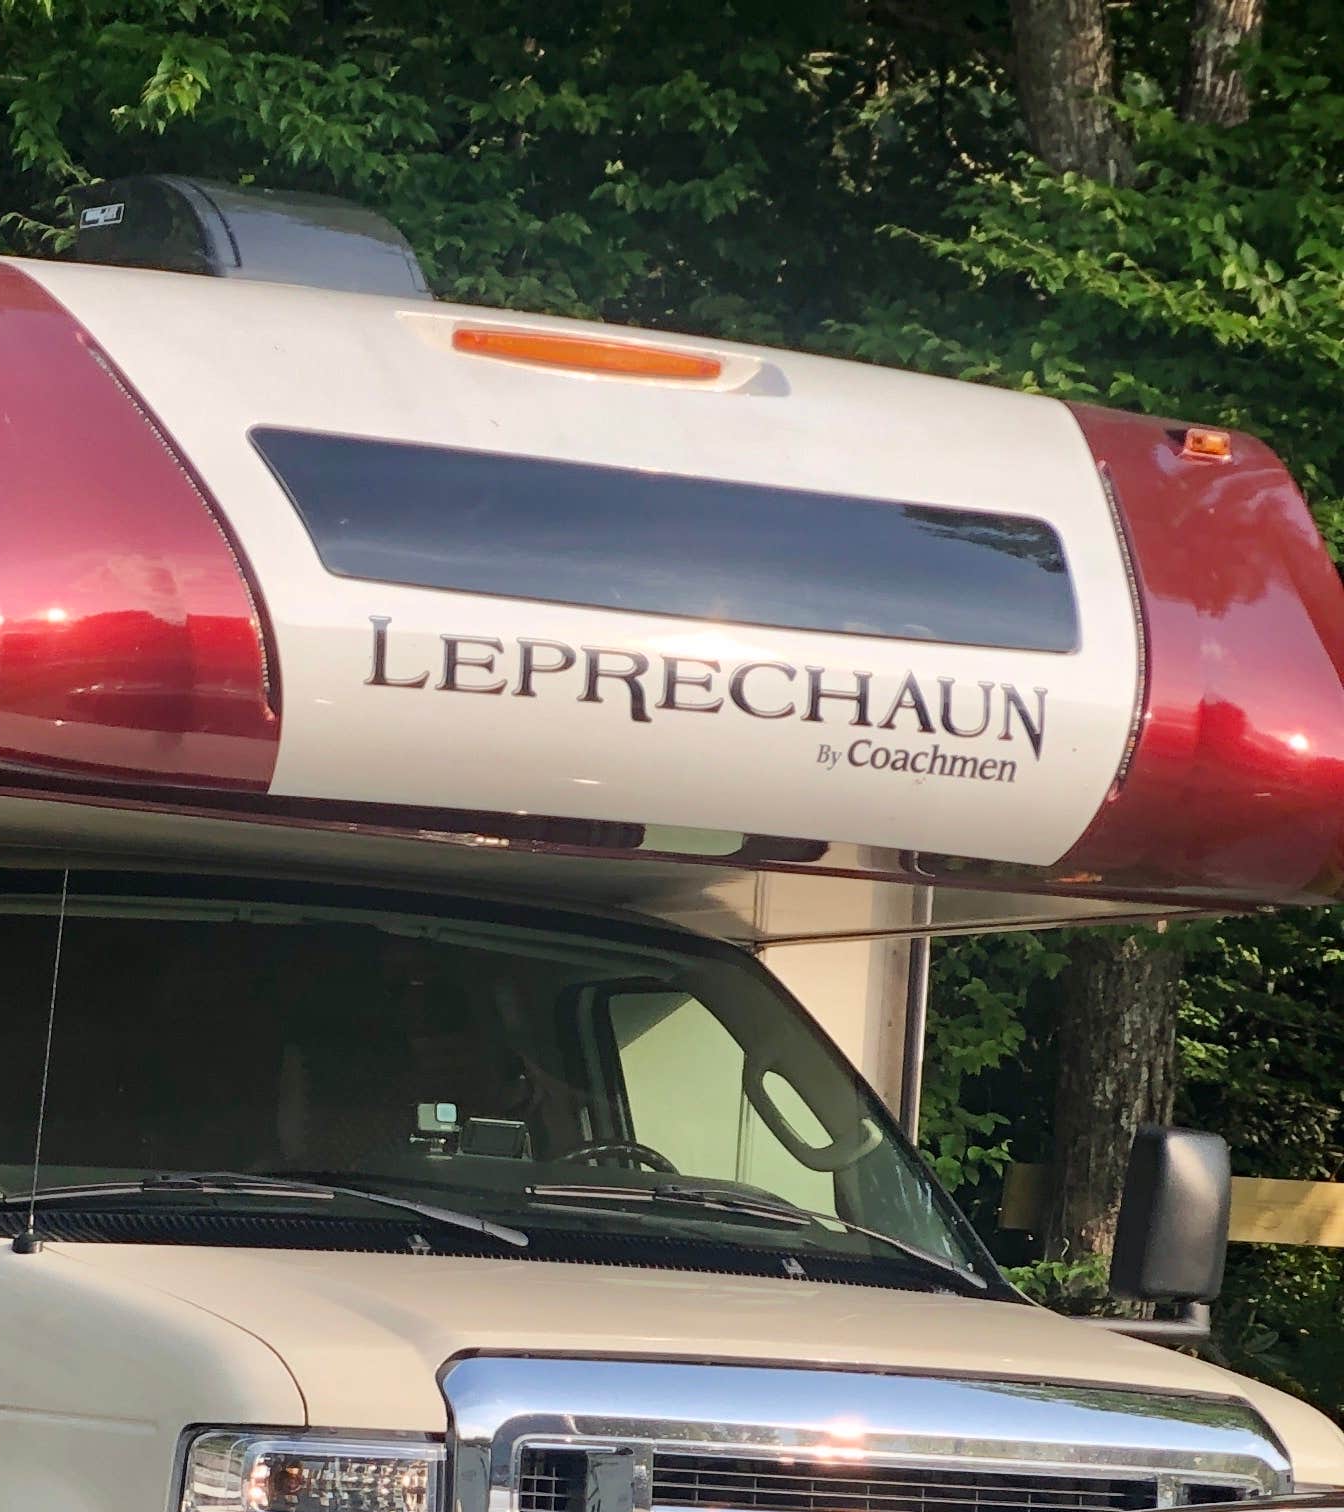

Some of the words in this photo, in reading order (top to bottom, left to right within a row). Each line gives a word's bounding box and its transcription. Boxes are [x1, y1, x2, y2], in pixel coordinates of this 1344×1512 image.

[363, 615, 1049, 762] LEPRECHAUN
[816, 743, 842, 770] By
[847, 738, 1018, 783] Coachmen
